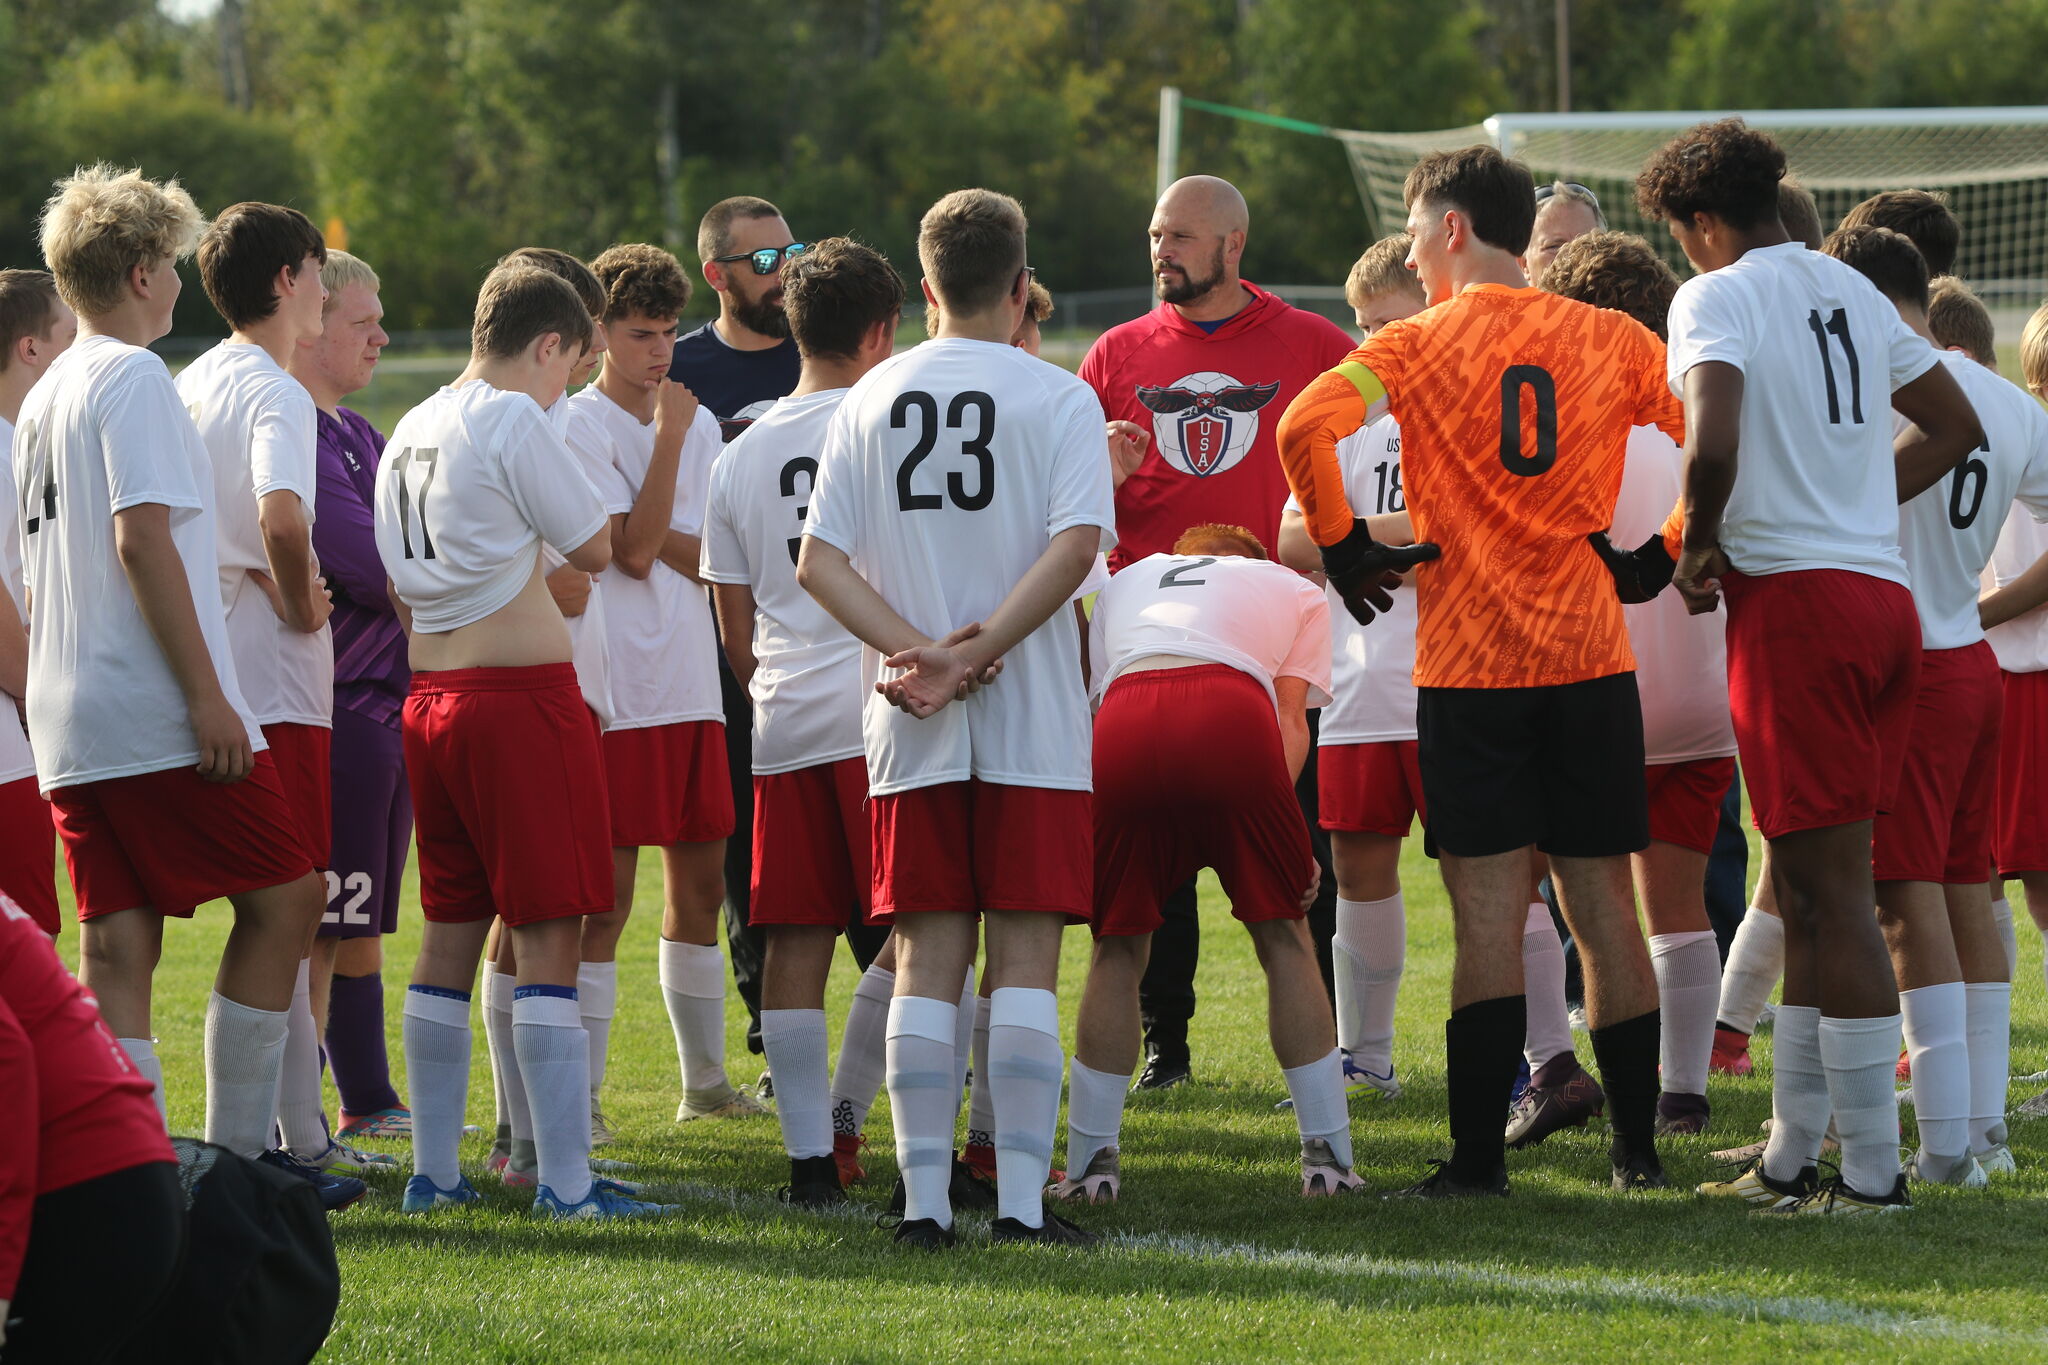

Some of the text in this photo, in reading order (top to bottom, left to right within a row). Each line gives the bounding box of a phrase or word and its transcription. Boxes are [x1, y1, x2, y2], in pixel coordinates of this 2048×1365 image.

[1807, 308, 1864, 424] 11
[890, 390, 996, 512] 23
[1197, 421, 1211, 467] USA
[1500, 364, 1557, 477] 0
[391, 447, 439, 560] 17
[1374, 461, 1407, 514] 18
[1949, 431, 1990, 530] 6
[1159, 557, 1218, 590] 2
[320, 870, 372, 925] 22
